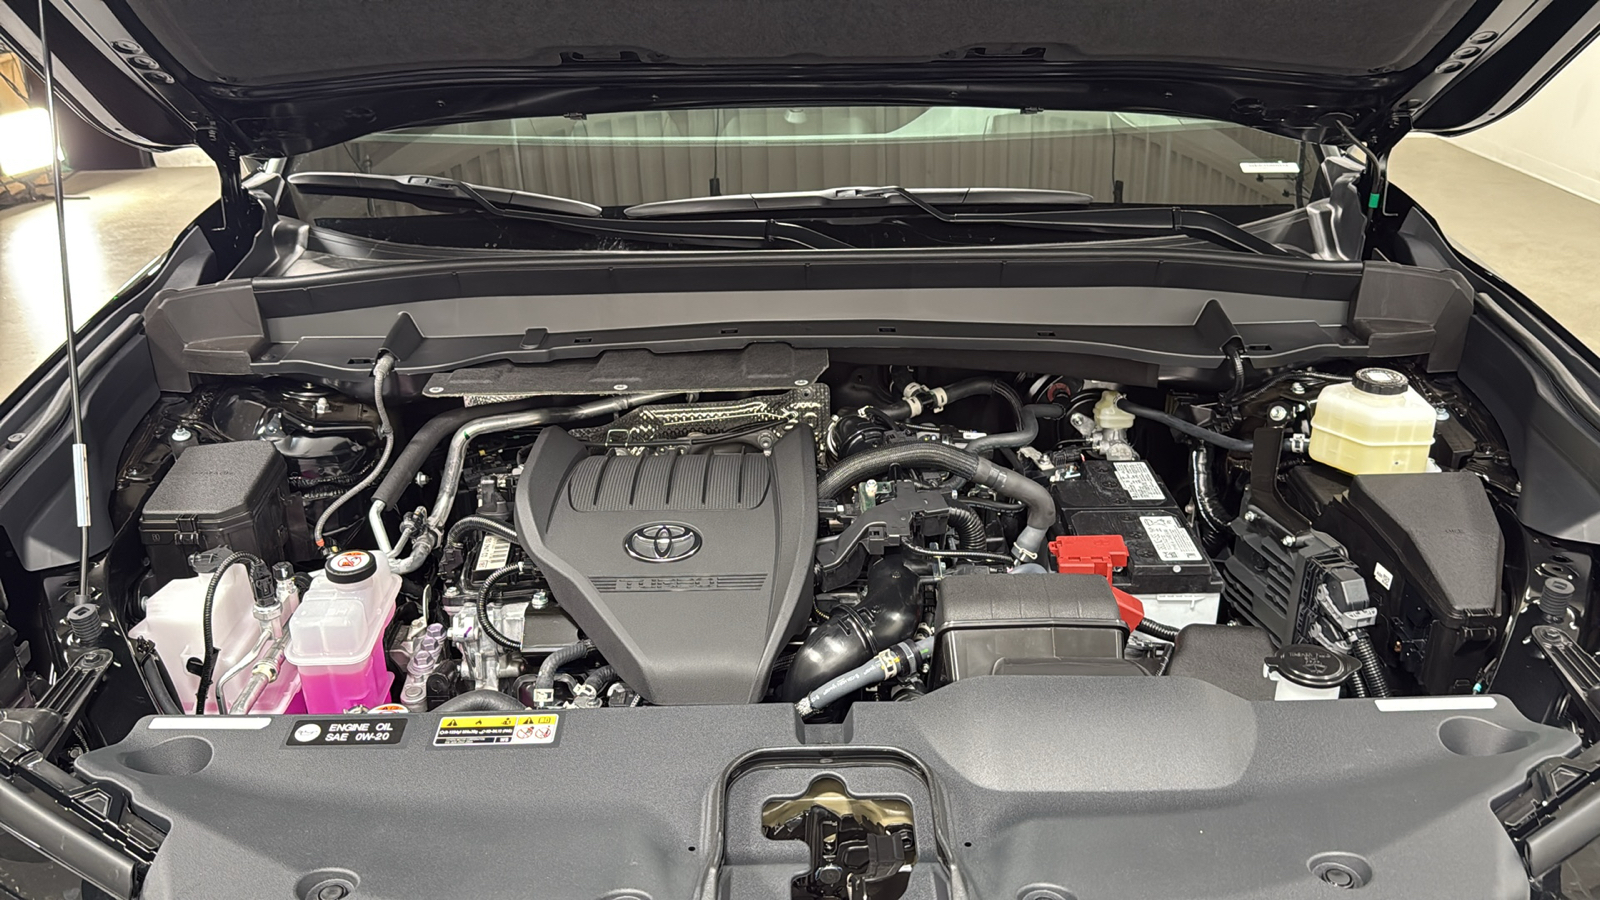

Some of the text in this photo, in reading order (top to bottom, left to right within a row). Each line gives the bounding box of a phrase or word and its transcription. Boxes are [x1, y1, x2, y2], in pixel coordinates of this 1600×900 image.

[619, 577, 715, 589] TURBO
[328, 723, 394, 732] ENGINE OIL
[325, 732, 390, 742] SAE 0W-20
